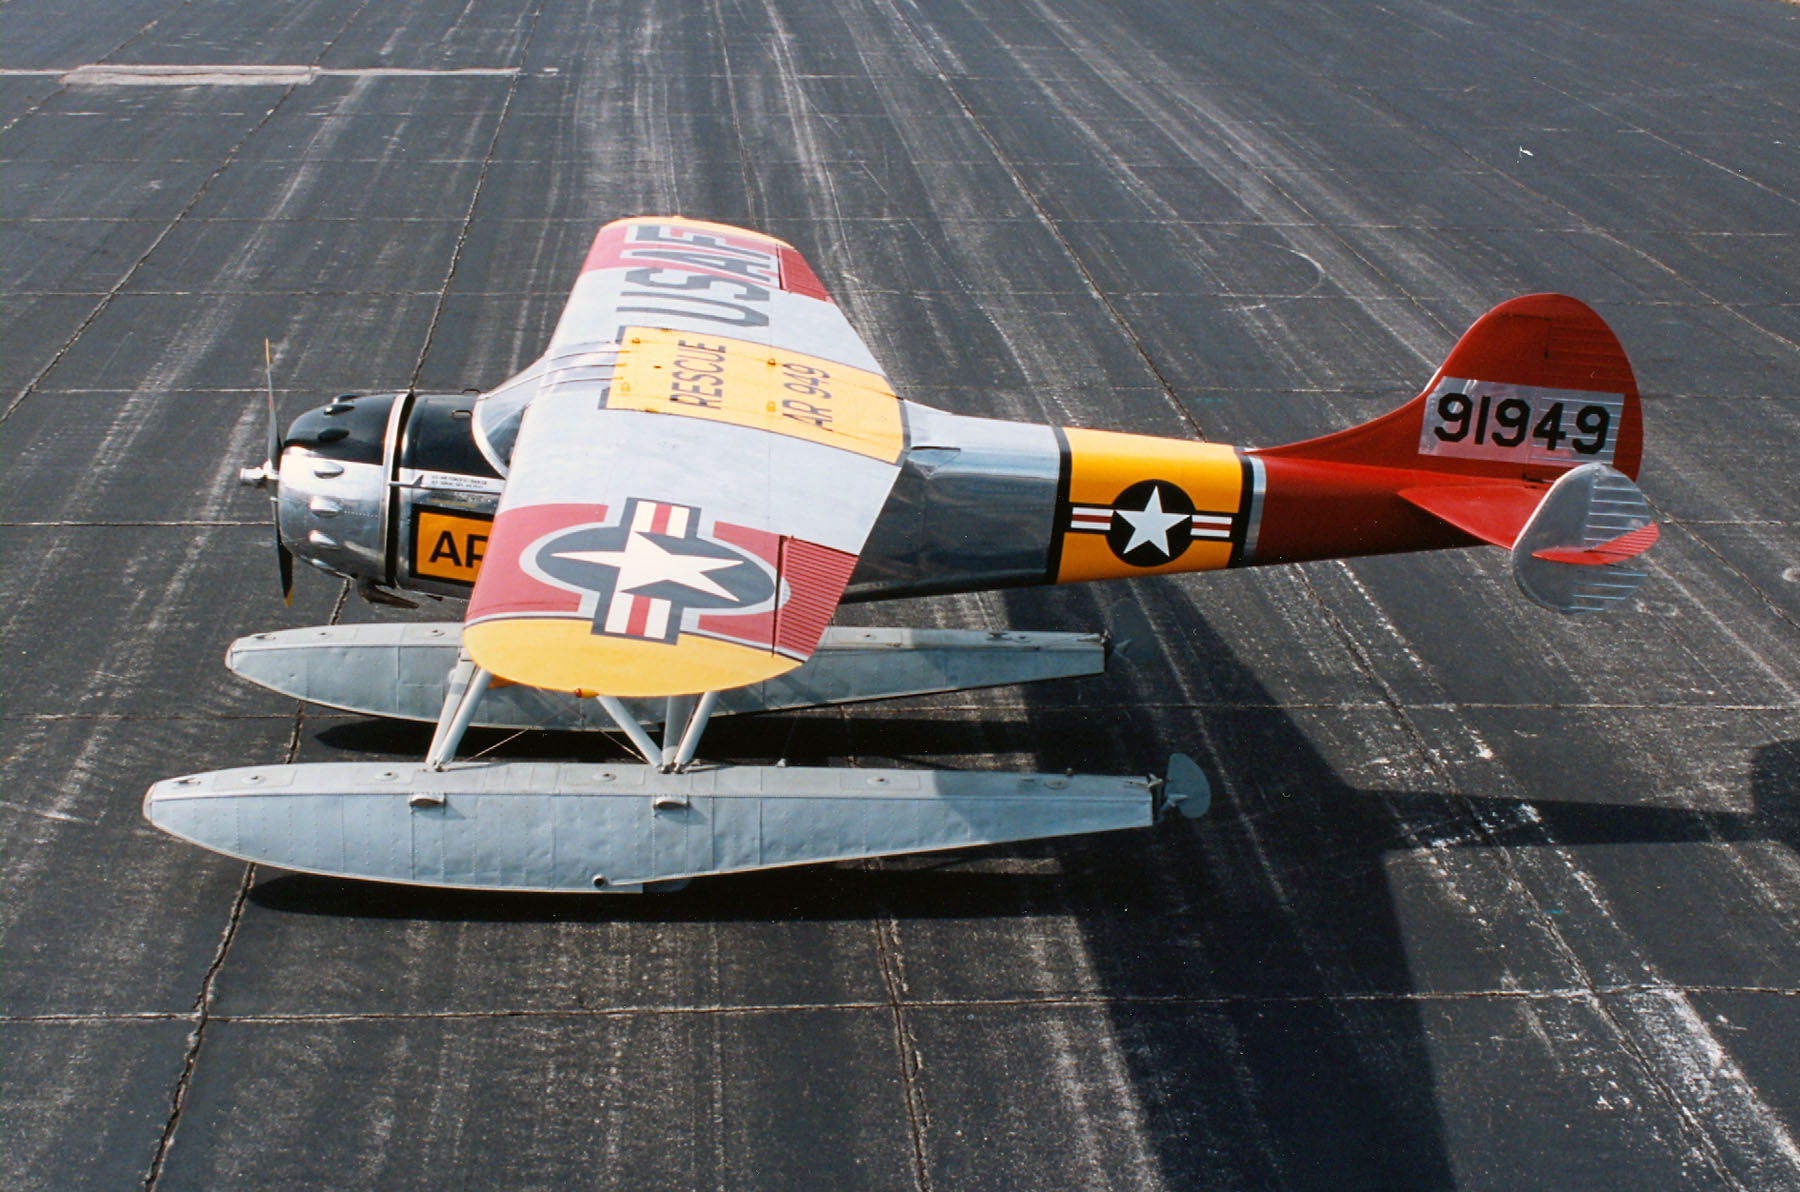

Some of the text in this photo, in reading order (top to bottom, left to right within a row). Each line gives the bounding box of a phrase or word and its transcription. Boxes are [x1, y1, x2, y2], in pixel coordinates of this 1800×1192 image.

[616, 225, 771, 327] USAF
[669, 340, 726, 410] RESCUE
[782, 363, 834, 432] AR 949
[1433, 392, 1611, 455] 91949
